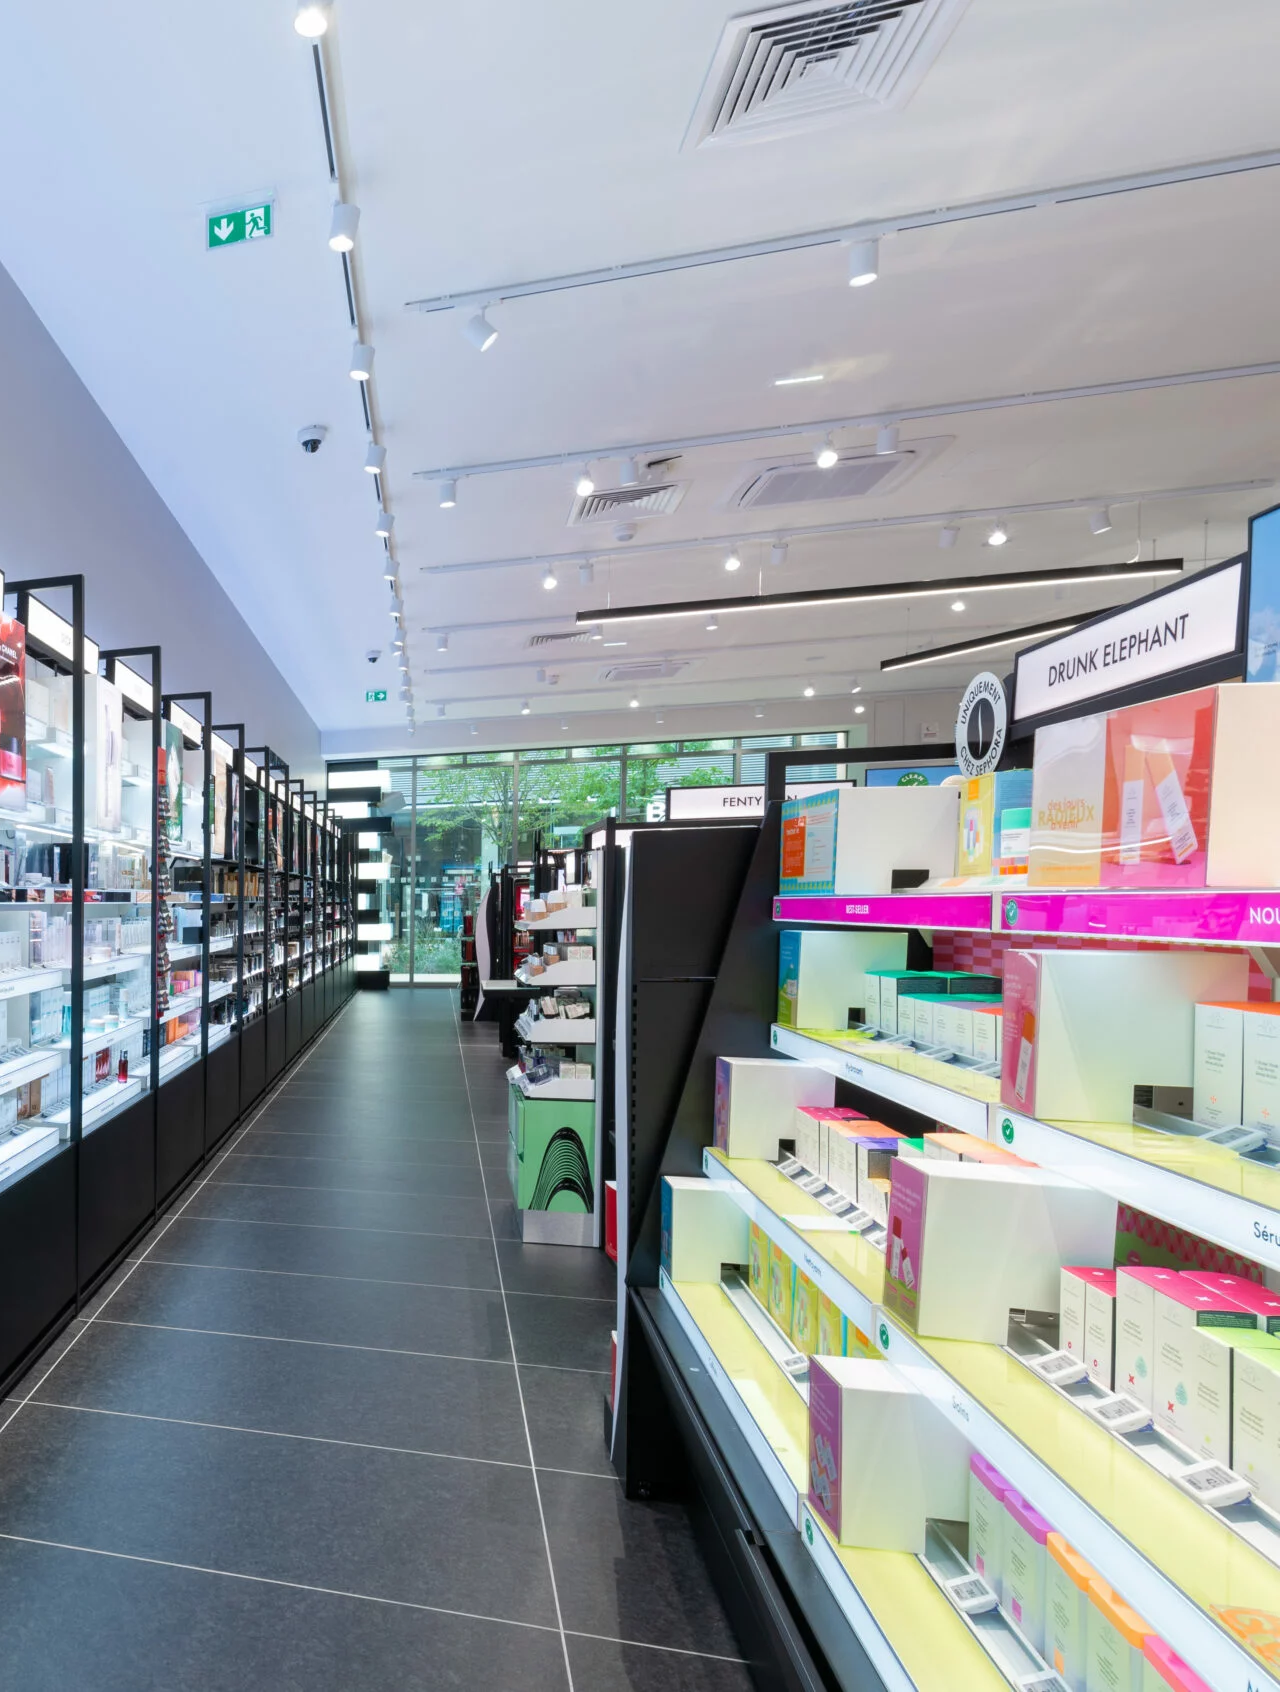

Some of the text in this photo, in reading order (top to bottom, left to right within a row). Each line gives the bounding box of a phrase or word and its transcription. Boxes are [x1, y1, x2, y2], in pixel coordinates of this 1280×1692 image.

[1, 643, 18, 660] CHANEL
[1048, 613, 1190, 687] DRUNK ELEPHANT
[960, 681, 1001, 725] UNIQUEMENT
[960, 727, 1003, 776] CHEZ SEPHORA
[722, 796, 762, 807] FENTY
[1037, 804, 1095, 827] RADIEUX
[845, 904, 869, 915] BEST-SELLER
